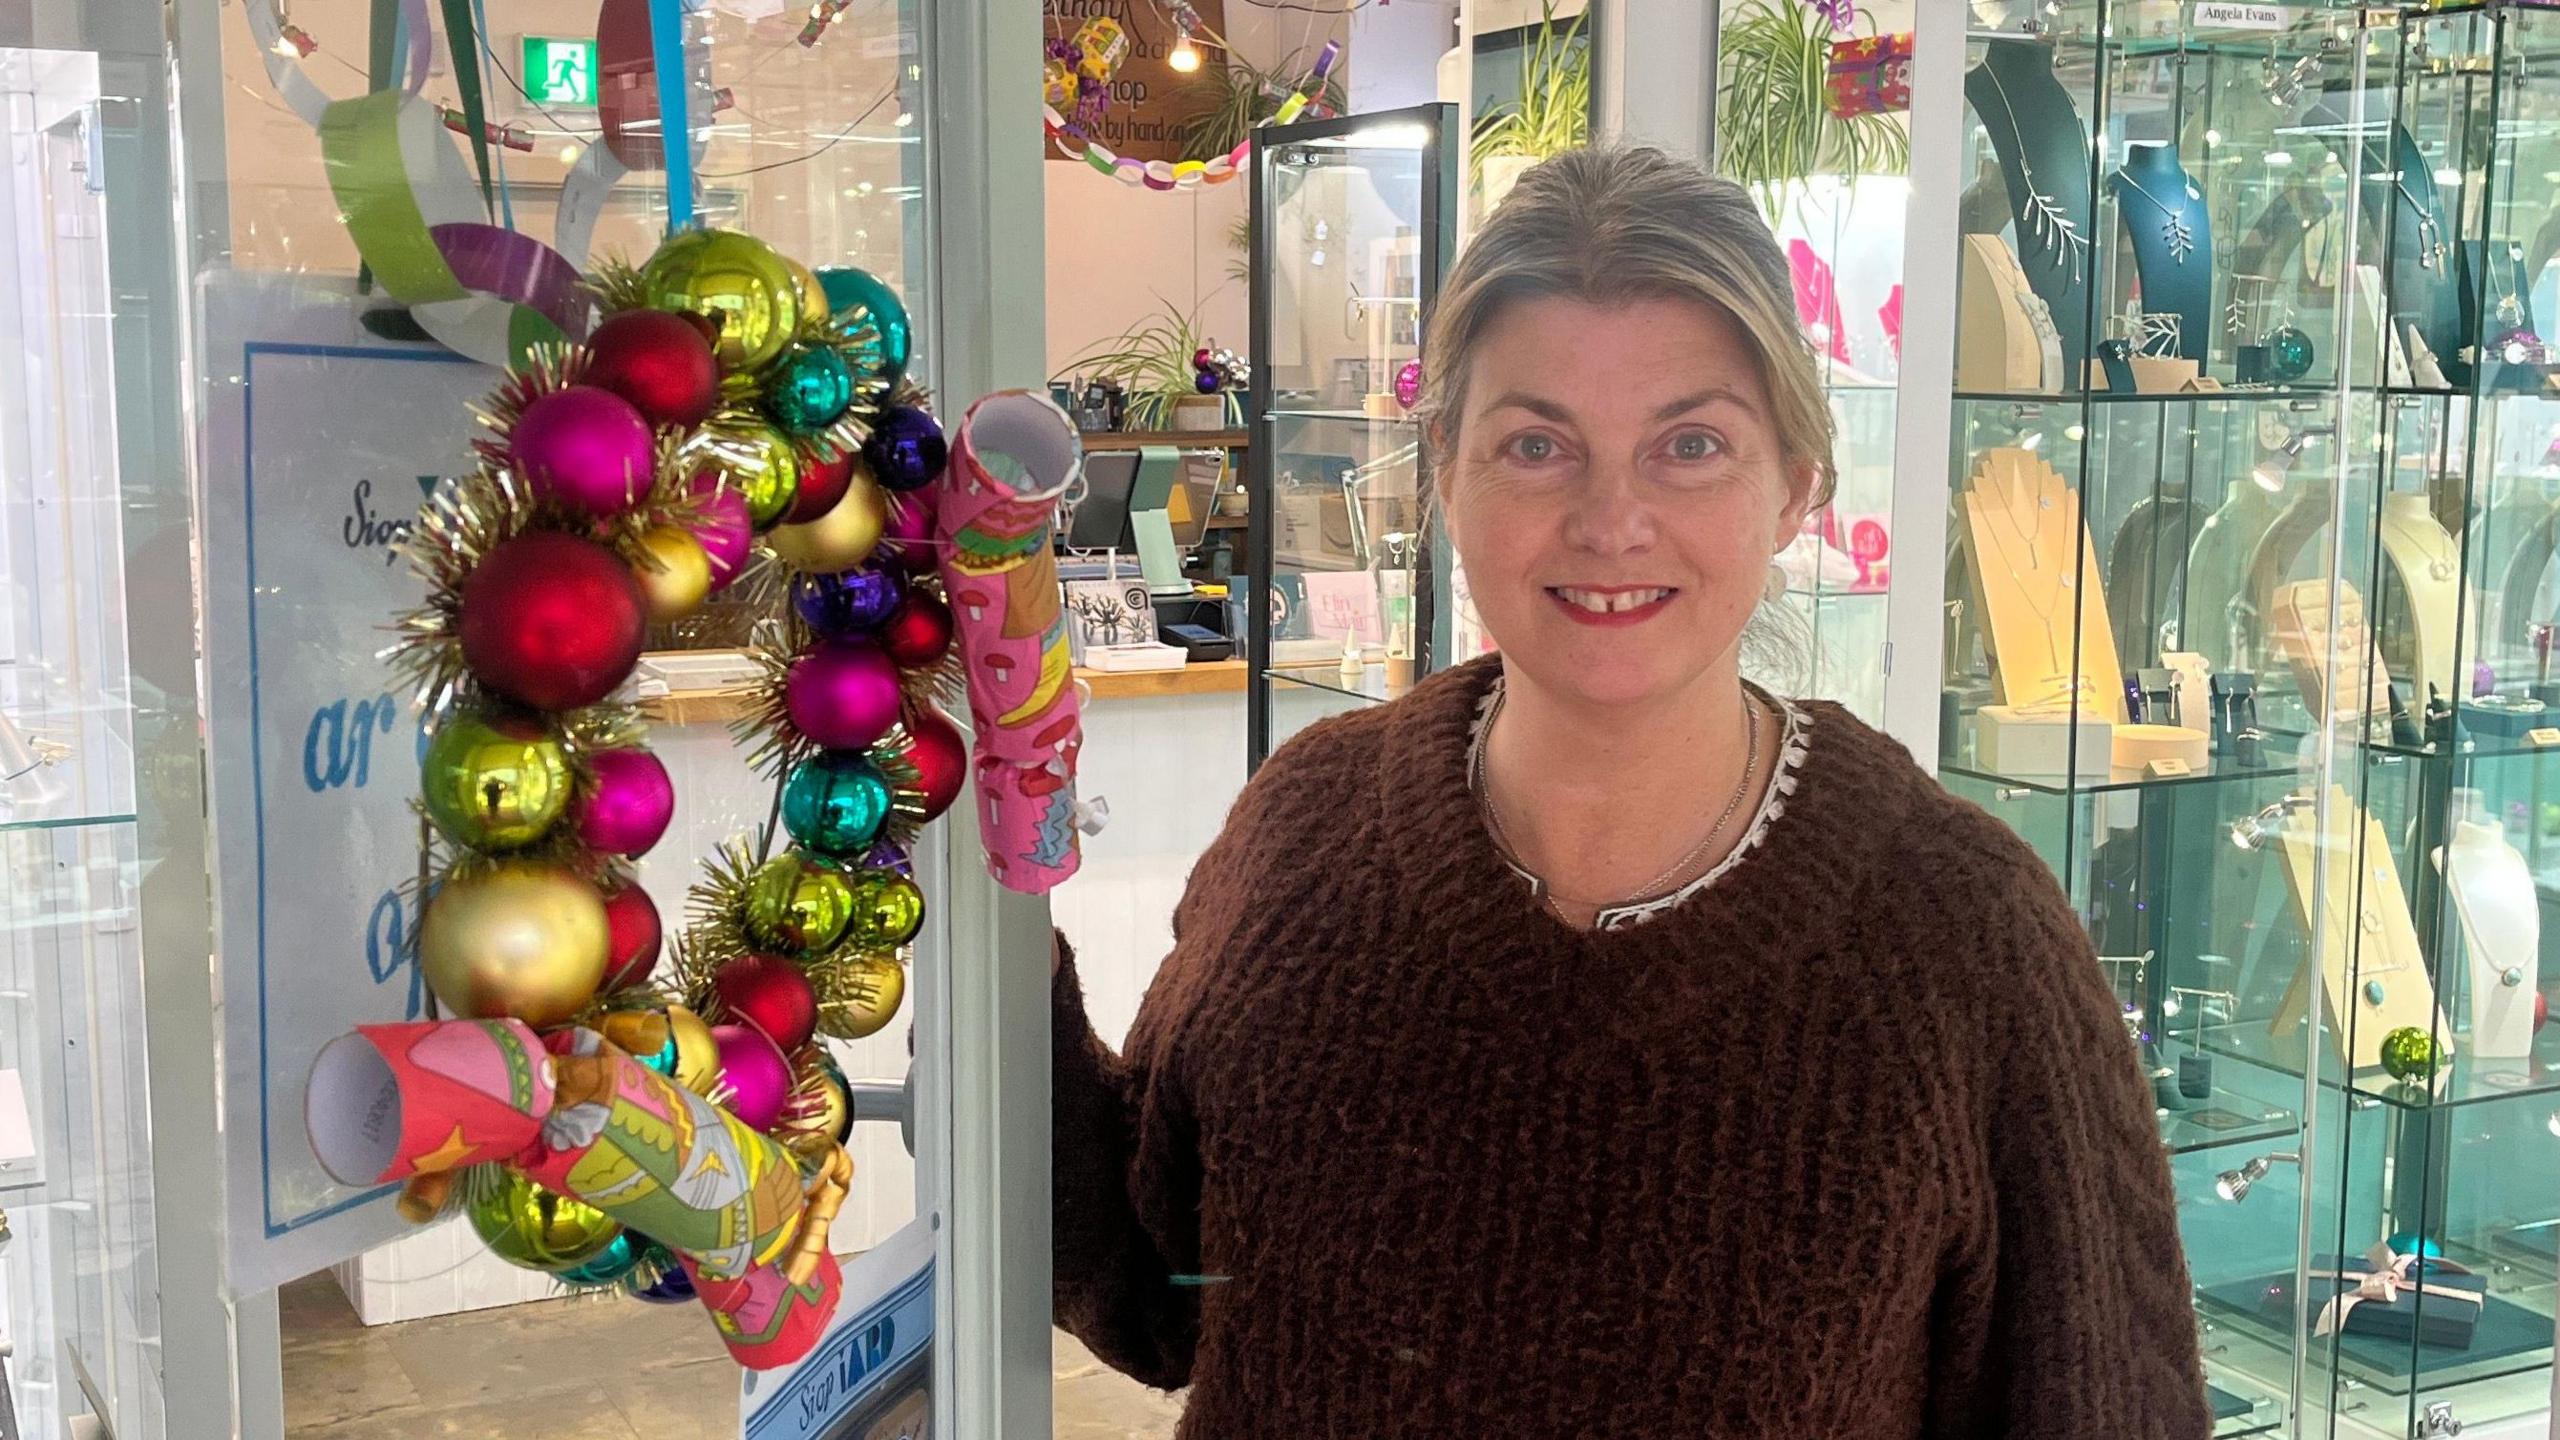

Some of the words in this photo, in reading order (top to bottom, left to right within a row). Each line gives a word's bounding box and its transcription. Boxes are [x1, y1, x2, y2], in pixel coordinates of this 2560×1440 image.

[2204, 6, 2243, 20] Angela
[2246, 8, 2277, 21] Evans
[1105, 115, 1124, 147] by
[1127, 115, 1164, 141] hand
[304, 693, 396, 793] ar
[799, 1371, 834, 1431] Siop
